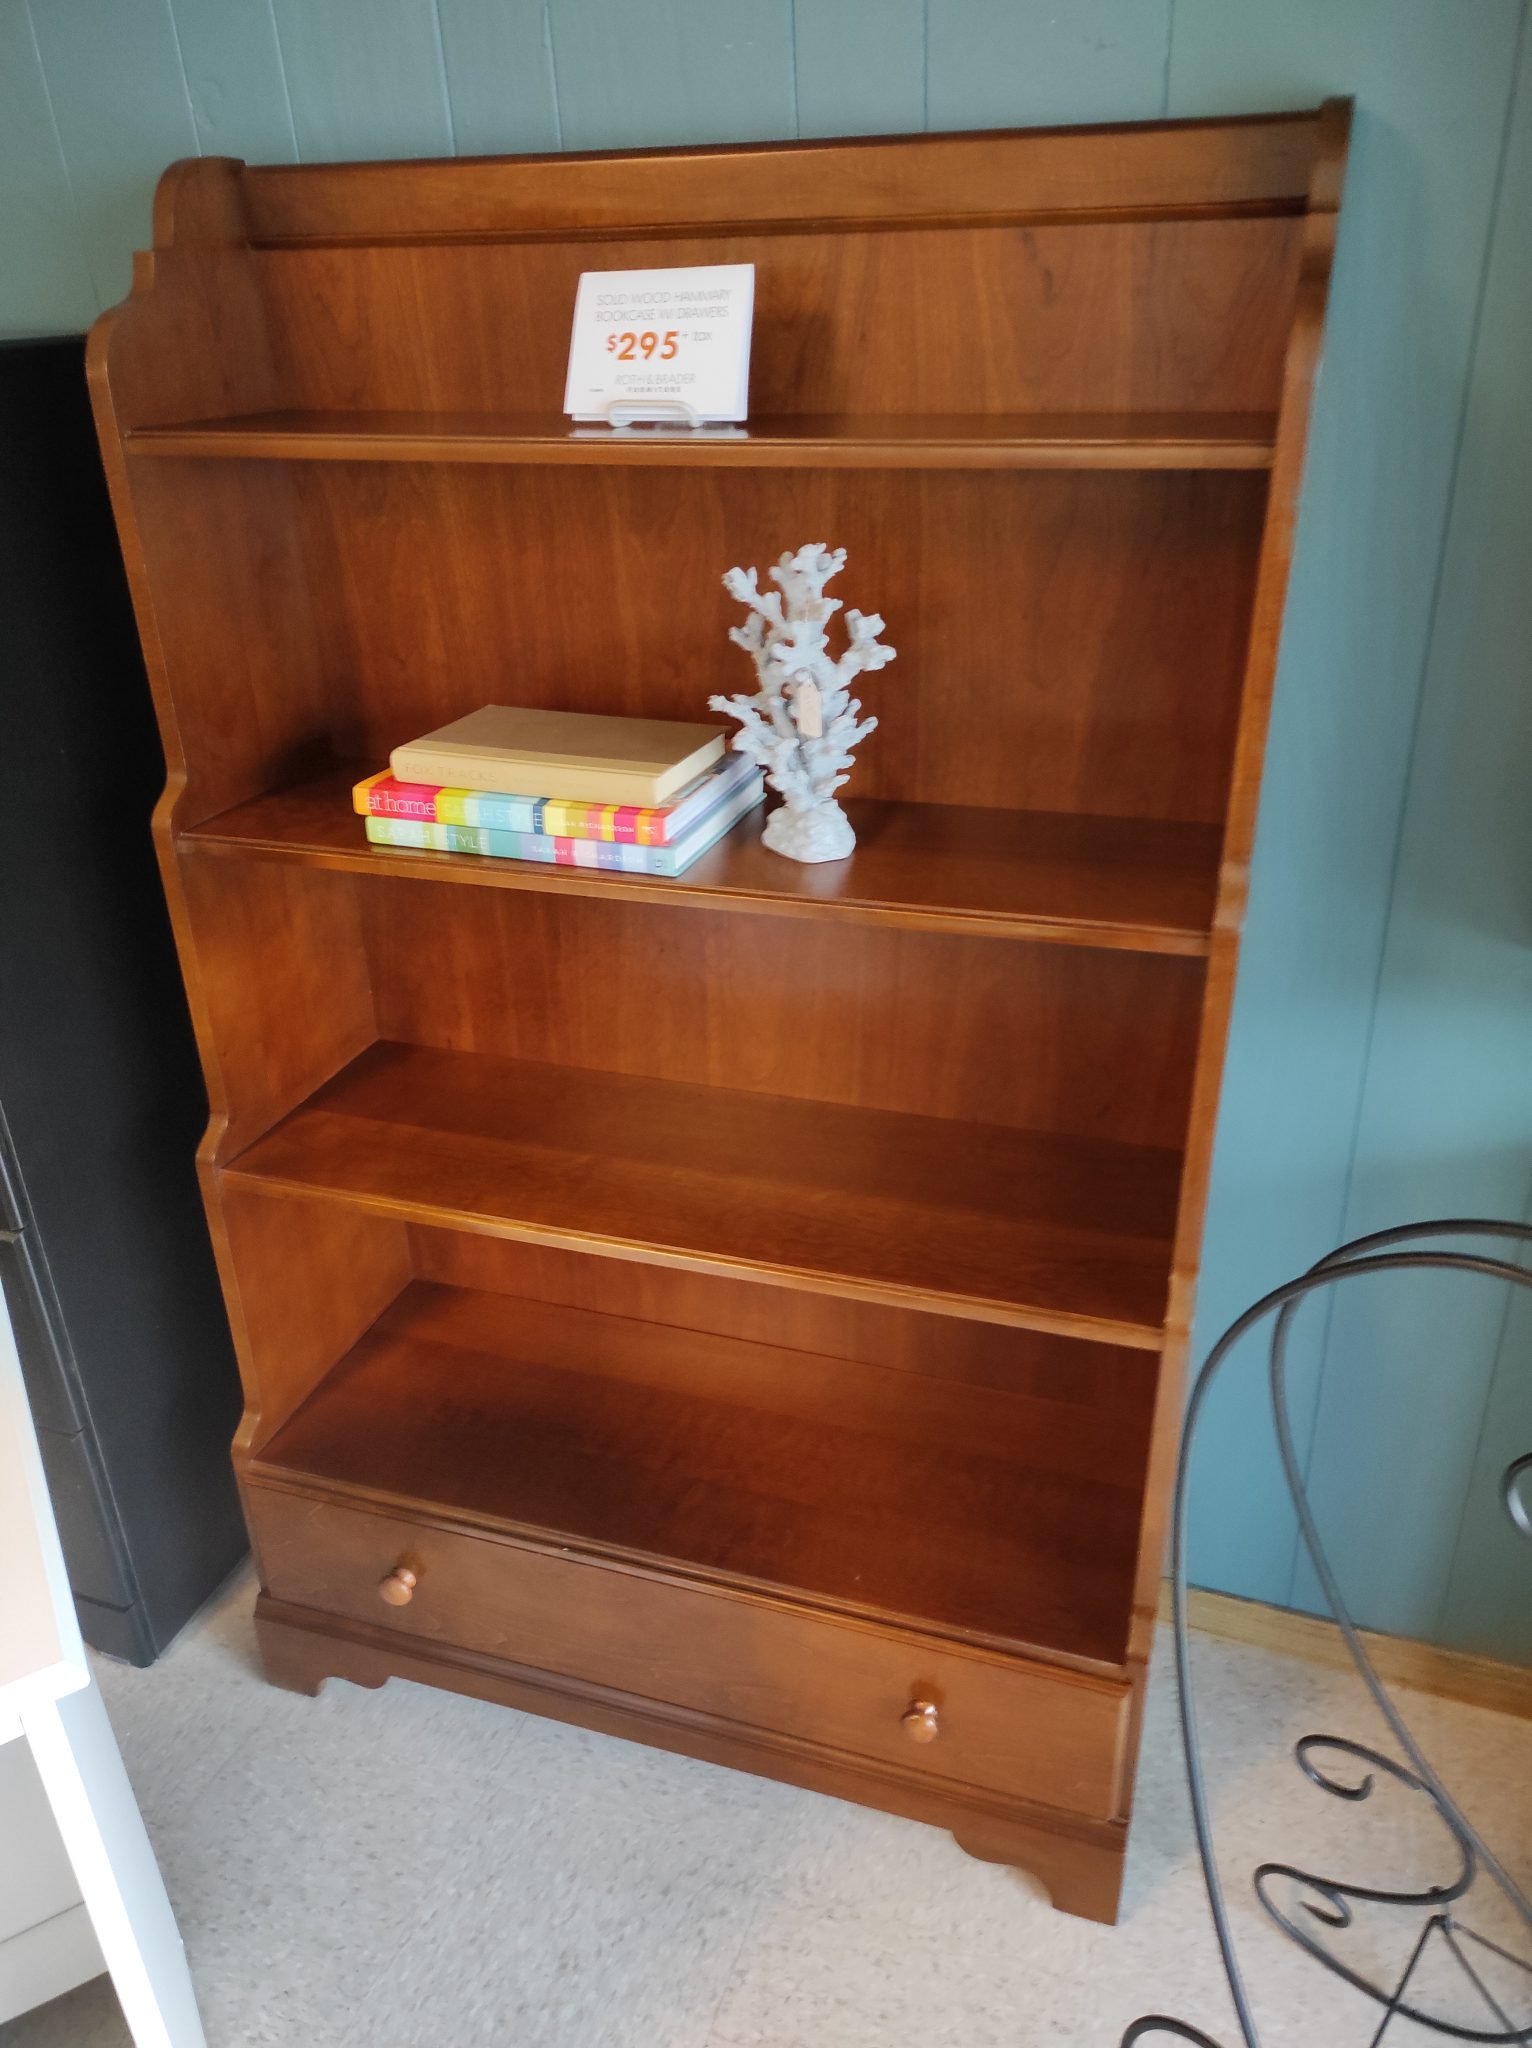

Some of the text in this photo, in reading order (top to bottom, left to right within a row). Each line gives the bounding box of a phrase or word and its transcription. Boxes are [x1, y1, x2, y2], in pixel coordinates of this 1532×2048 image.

[596, 294, 628, 306] SOLID
[631, 292, 672, 304] WOOD
[595, 309, 656, 322] BOOKCASE
[677, 306, 729, 319] DRAWERS
[606, 330, 680, 361] $295
[367, 794, 383, 811] at
[384, 791, 437, 816] home
